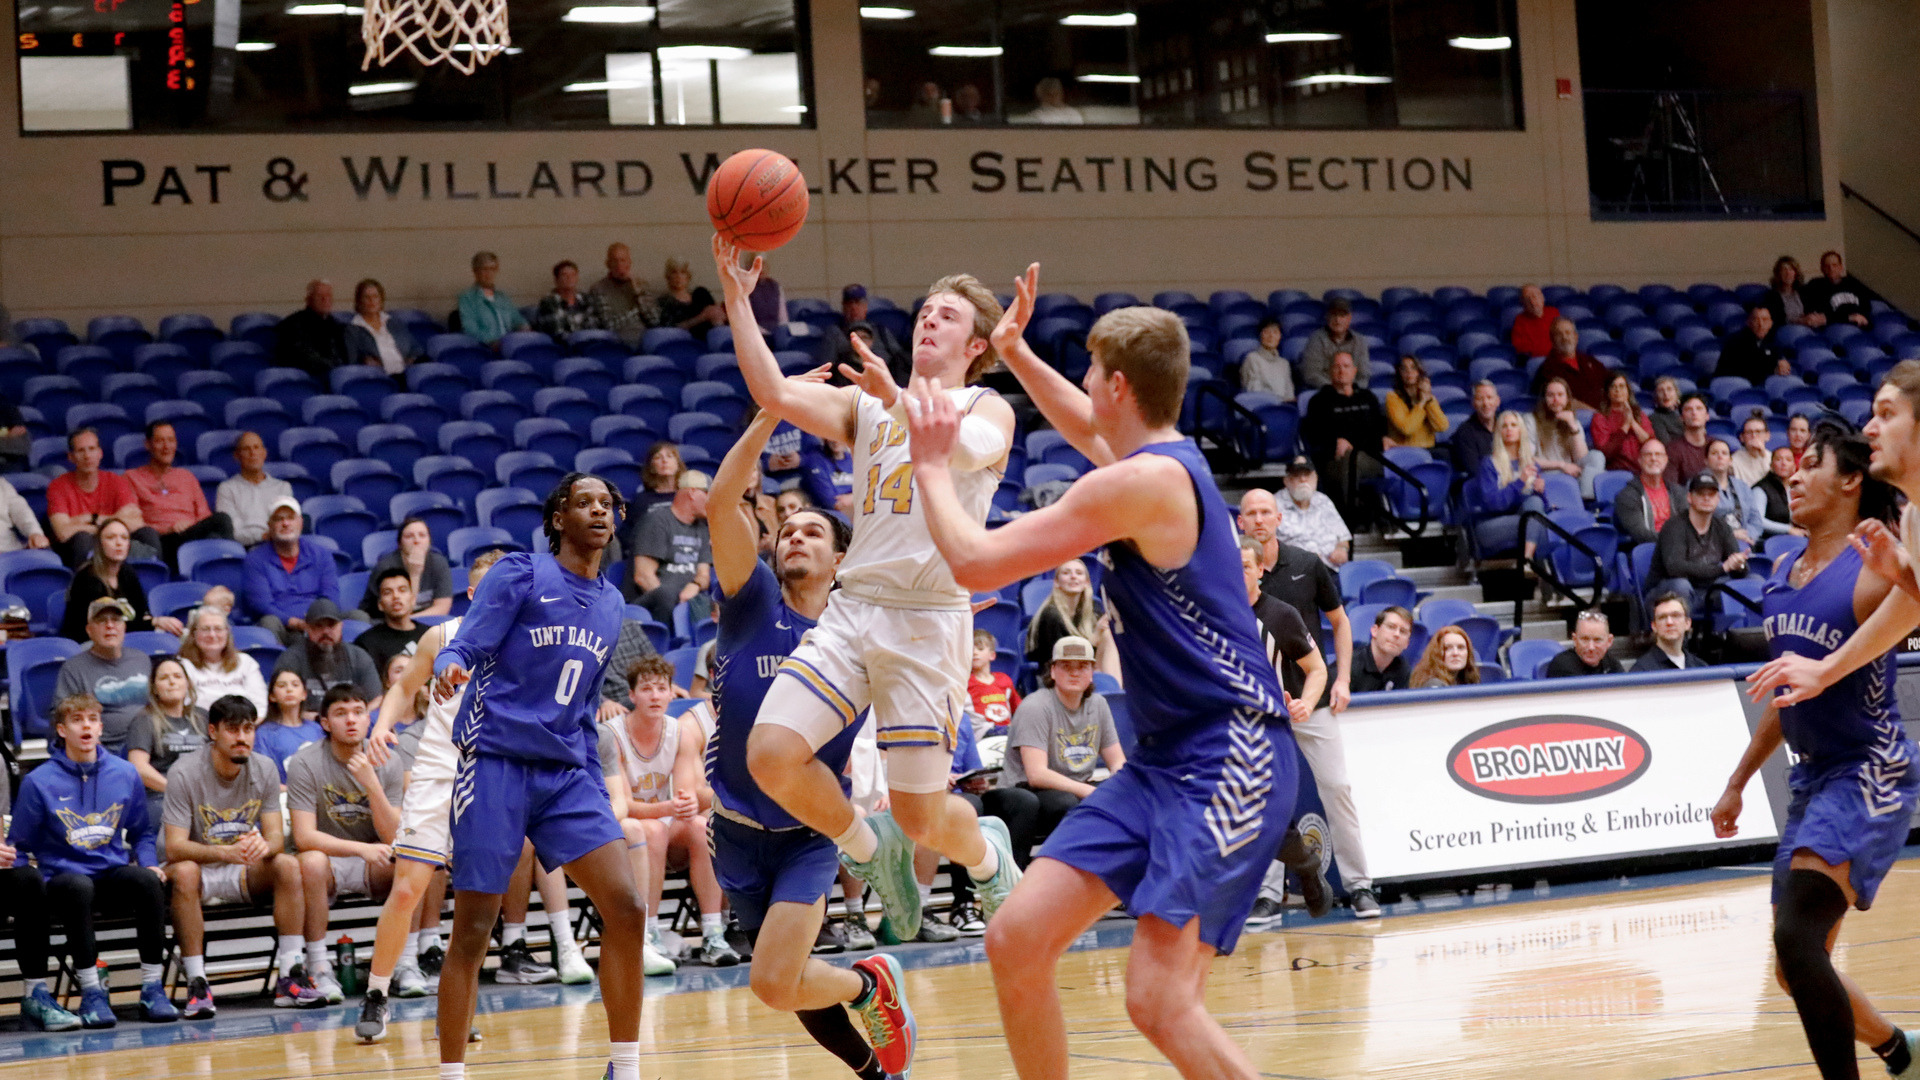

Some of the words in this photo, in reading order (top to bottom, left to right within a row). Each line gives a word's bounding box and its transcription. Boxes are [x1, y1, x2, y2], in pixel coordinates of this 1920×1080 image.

[101, 157, 232, 208] PAT
[262, 155, 310, 204] &
[341, 154, 655, 201] WILLARD
[679, 151, 940, 196] WKER
[969, 150, 1217, 194] SEATING
[1244, 150, 1474, 193] SECTION
[862, 460, 915, 516] 14
[529, 625, 565, 648] UNT
[567, 625, 609, 667] DALLA
[1777, 612, 1844, 651] DALLAS
[554, 658, 584, 707] 0
[755, 654, 790, 679] UN
[1471, 738, 1624, 782] BROADWAY
[1409, 829, 1483, 852] Screen
[1490, 817, 1577, 843] Printing
[1581, 812, 1598, 834] &
[1606, 802, 1715, 832] Embroider
